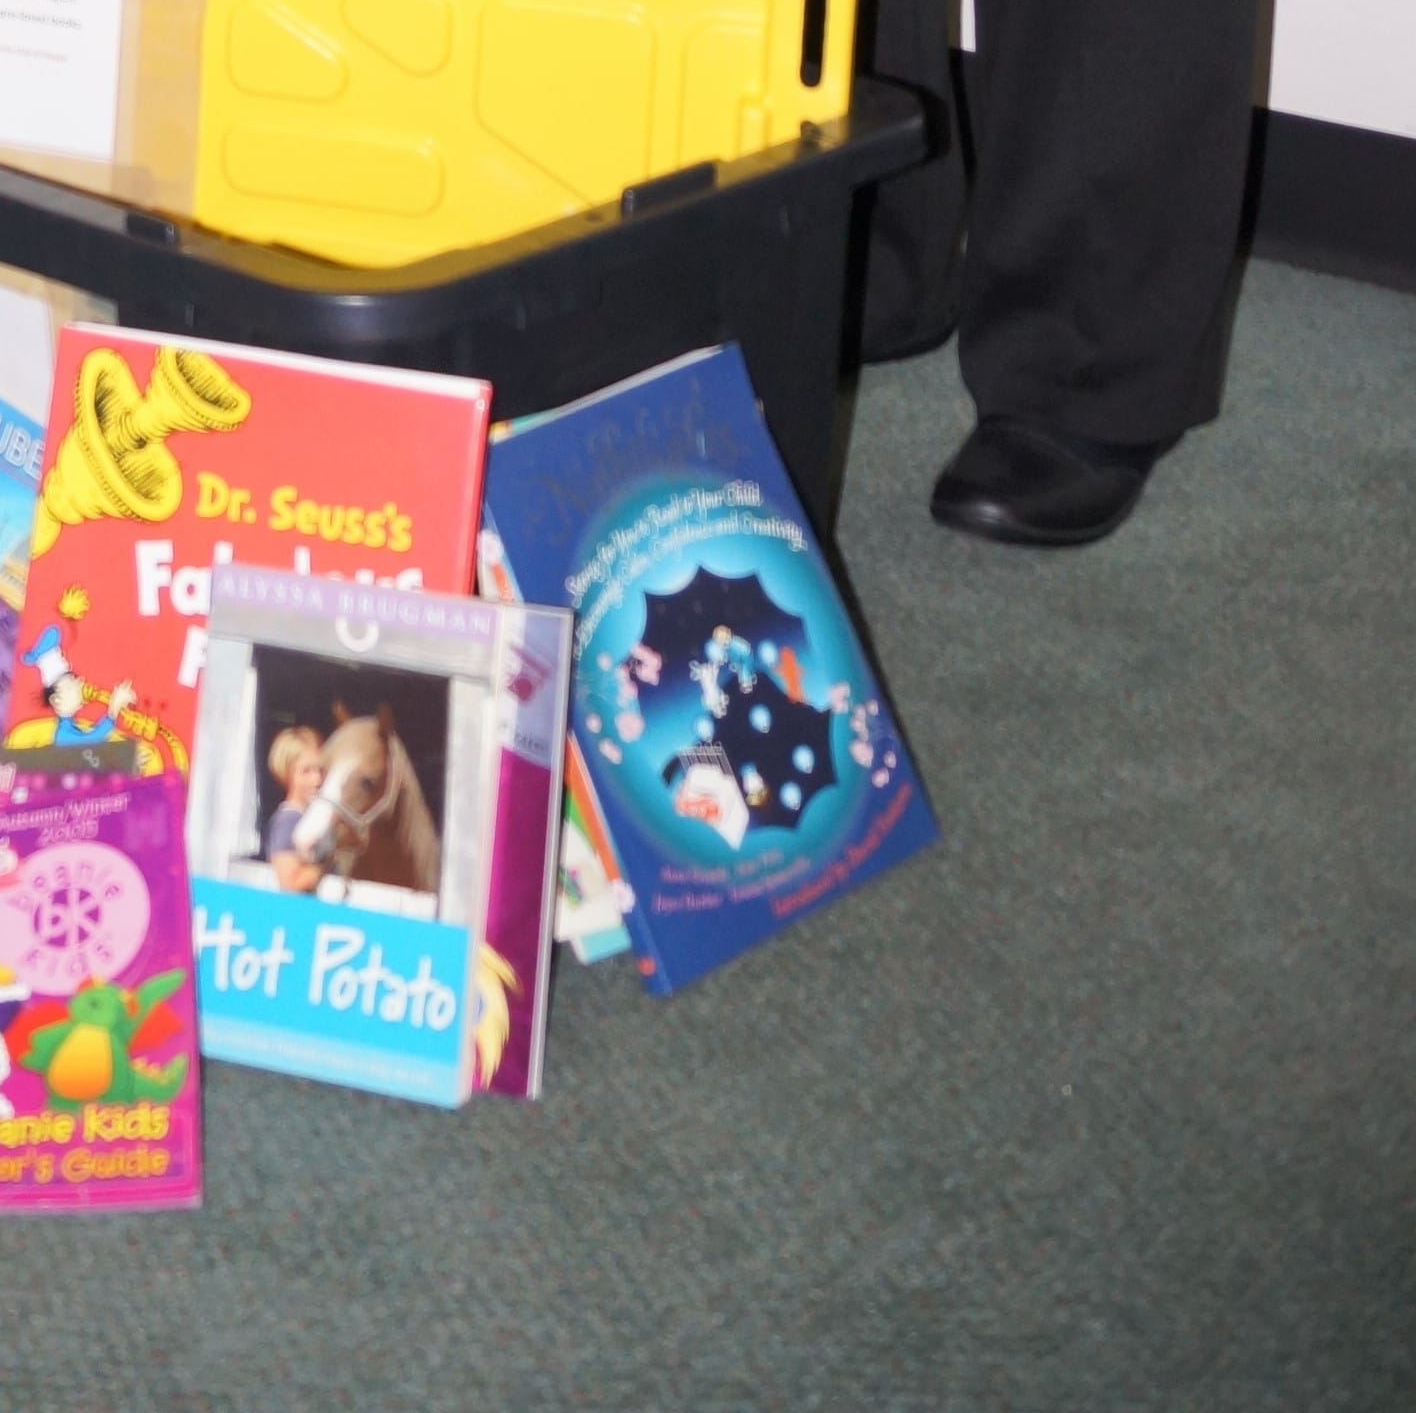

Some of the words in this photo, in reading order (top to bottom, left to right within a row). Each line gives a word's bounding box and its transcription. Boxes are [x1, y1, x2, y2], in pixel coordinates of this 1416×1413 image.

[195, 472, 257, 524] Dr.
[268, 485, 413, 552] Seuss's
[216, 573, 324, 610] ALYSSA
[337, 592, 491, 635] BRUGMAN
[192, 905, 295, 998] Hot
[308, 923, 456, 1031] Potato
[83, 1102, 170, 1144] Kids
[60, 1144, 171, 1183] Guide
